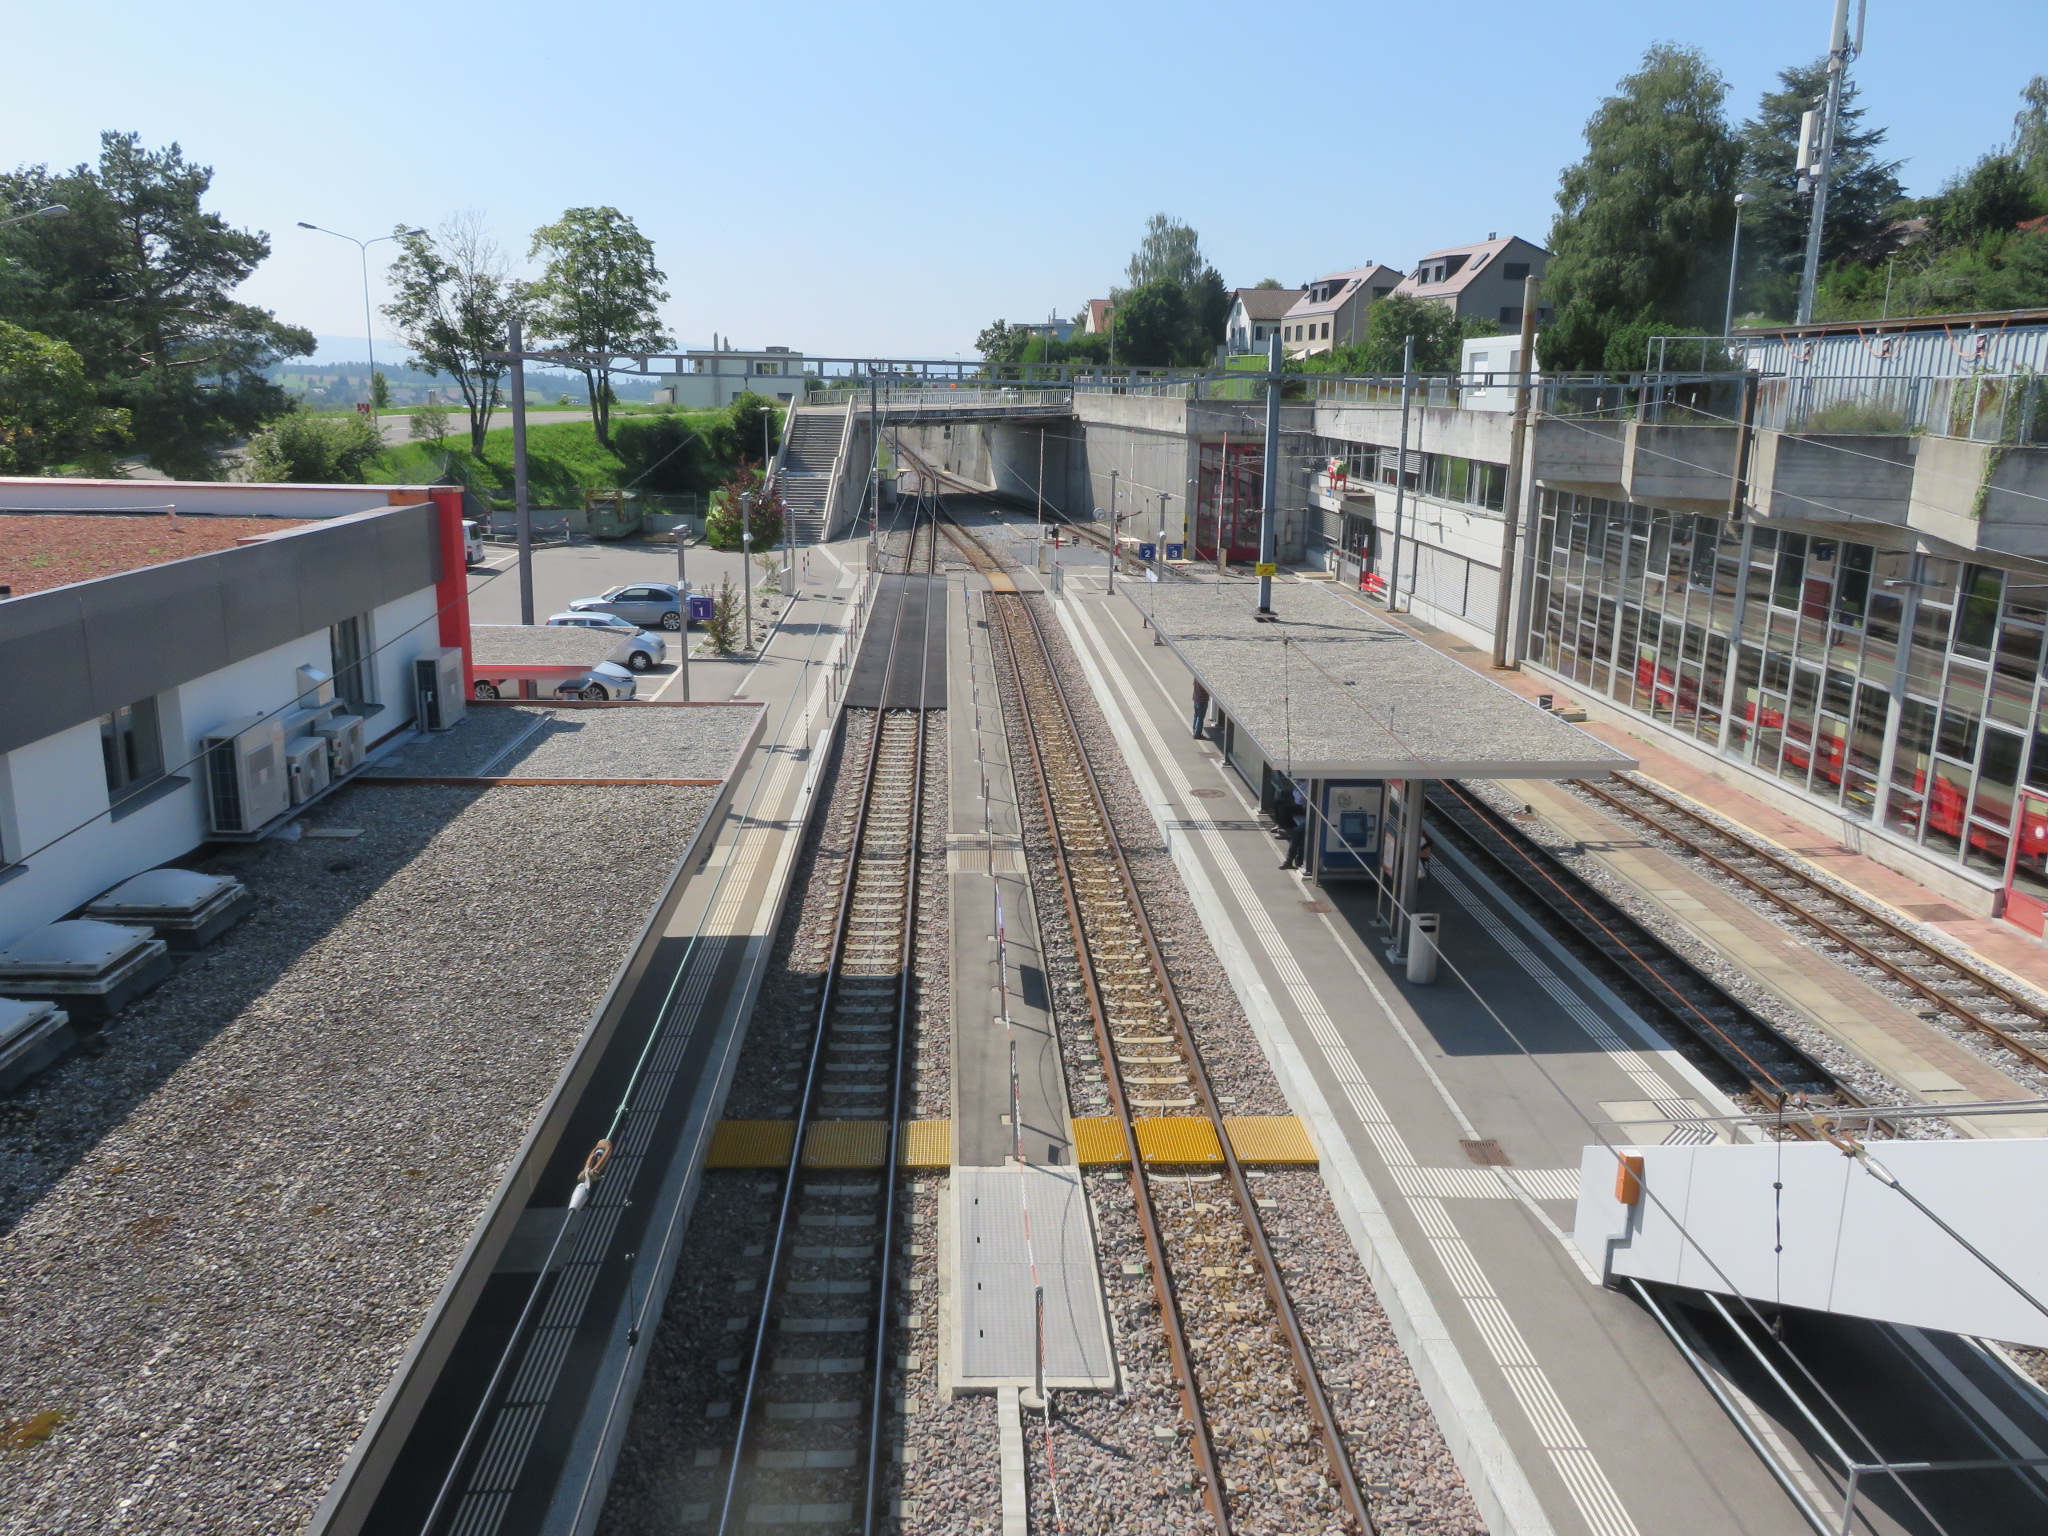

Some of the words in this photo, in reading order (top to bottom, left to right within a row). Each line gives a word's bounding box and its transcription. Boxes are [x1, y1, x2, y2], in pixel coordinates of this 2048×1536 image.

[1144, 550, 1151, 558] 2
[1171, 550, 1178, 558] 3
[698, 606, 704, 617] 1
